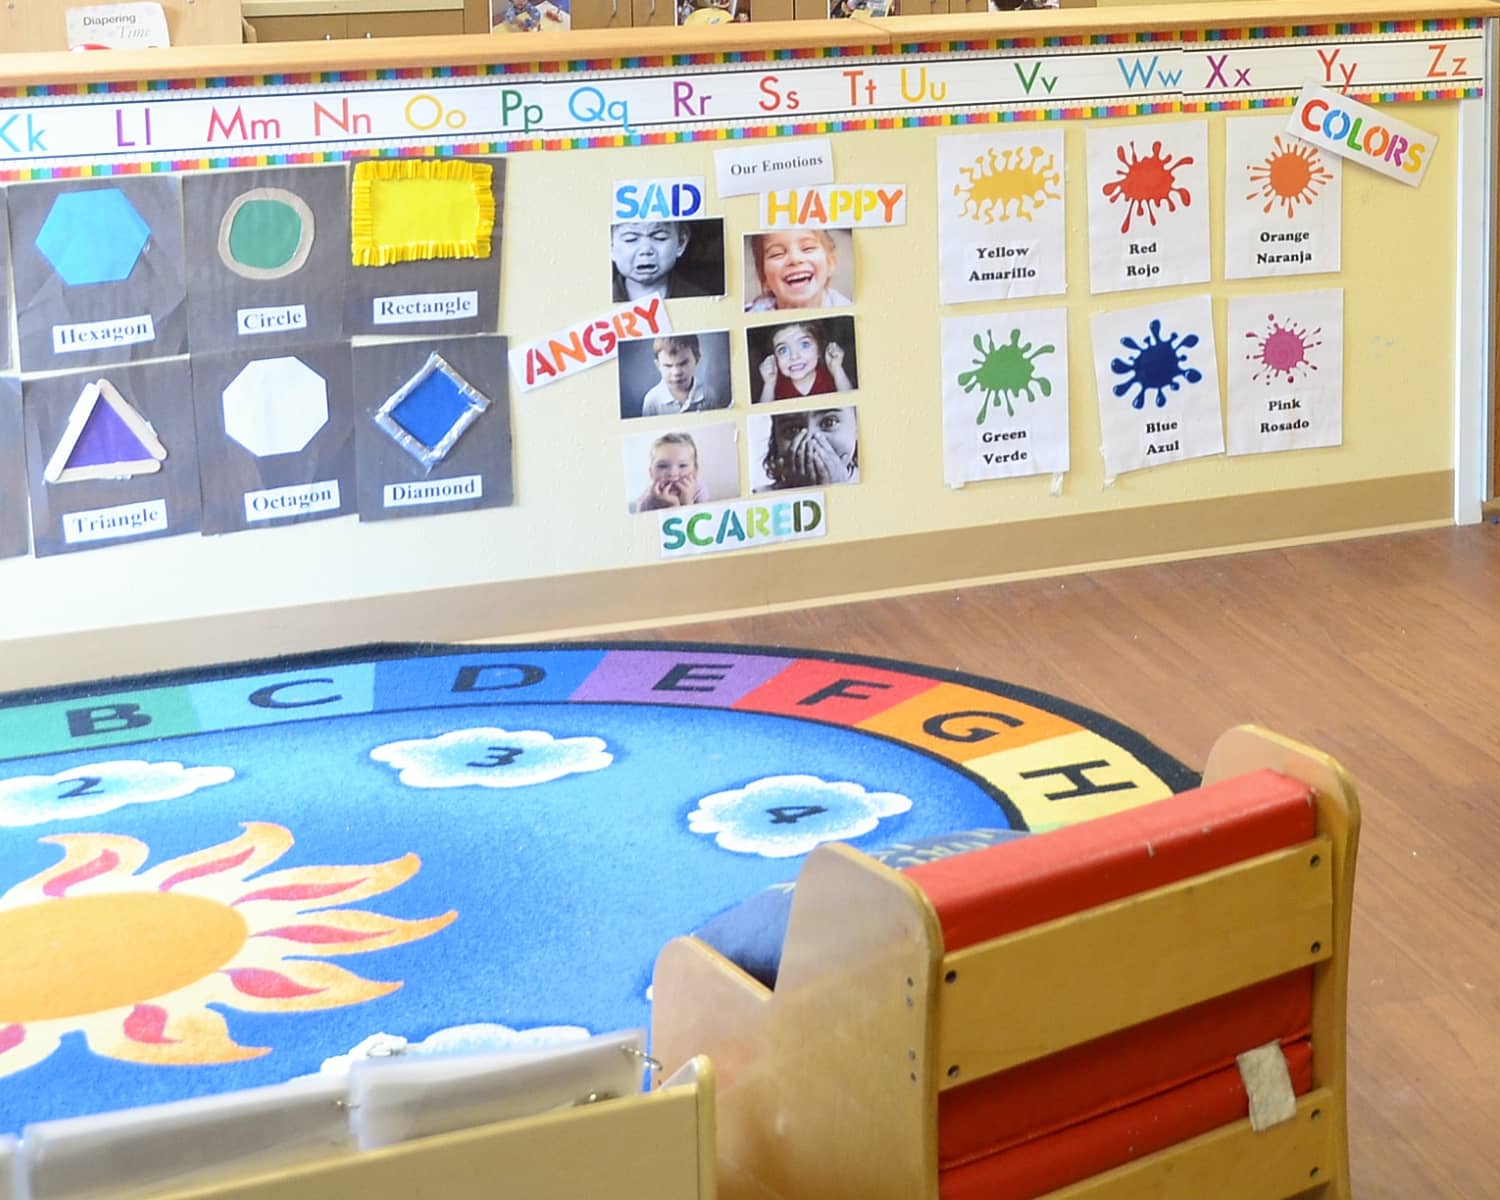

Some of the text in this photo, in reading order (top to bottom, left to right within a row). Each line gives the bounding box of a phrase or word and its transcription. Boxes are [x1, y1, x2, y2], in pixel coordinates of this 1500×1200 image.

[83, 13, 136, 27] Diapering
[0, 113, 48, 153] Kk
[206, 103, 281, 143] Mm
[313, 97, 373, 137] Nn
[405, 93, 468, 131] Oo
[501, 90, 544, 135] Pp
[568, 86, 638, 134] Qq
[672, 81, 712, 118] Rr
[757, 75, 801, 112] Ss
[842, 69, 878, 107] Tt
[900, 66, 947, 103] Uu
[1013, 61, 1059, 96] Vv
[1116, 55, 1184, 90] Ww
[1205, 54, 1253, 90] Xx
[1316, 47, 1359, 96] Yy
[1426, 44, 1468, 78] Zz
[1300, 99, 1427, 175] COLORS
[730, 153, 824, 176] Our Emotions
[616, 183, 702, 220] SAD
[767, 188, 904, 226] HAPPY
[1128, 242, 1158, 256] Red
[1259, 231, 1310, 245] Orange
[976, 246, 1030, 260] Yellow
[1256, 251, 1313, 266] Naranja
[968, 267, 1037, 282] Amarillo
[1126, 263, 1160, 278] Rojo
[380, 296, 472, 318] Rectangle
[243, 308, 303, 331] Circle
[60, 319, 148, 346] Hexagon
[525, 298, 661, 386] ANGRY
[1268, 399, 1301, 412] Pink
[982, 428, 1027, 444] Green
[1145, 419, 1178, 434] Blue
[1259, 419, 1310, 434] Rosado
[983, 450, 1028, 465] Verde
[1146, 441, 1180, 456] Azul
[252, 486, 332, 514] Octagon
[391, 477, 476, 502] Diamond
[73, 507, 160, 535] Triangle
[662, 499, 822, 550] SCARED
[66, 662, 1139, 801] B C D E F G H
[465, 746, 524, 768] 3
[57, 776, 105, 800] 2
[765, 804, 829, 825] 4
